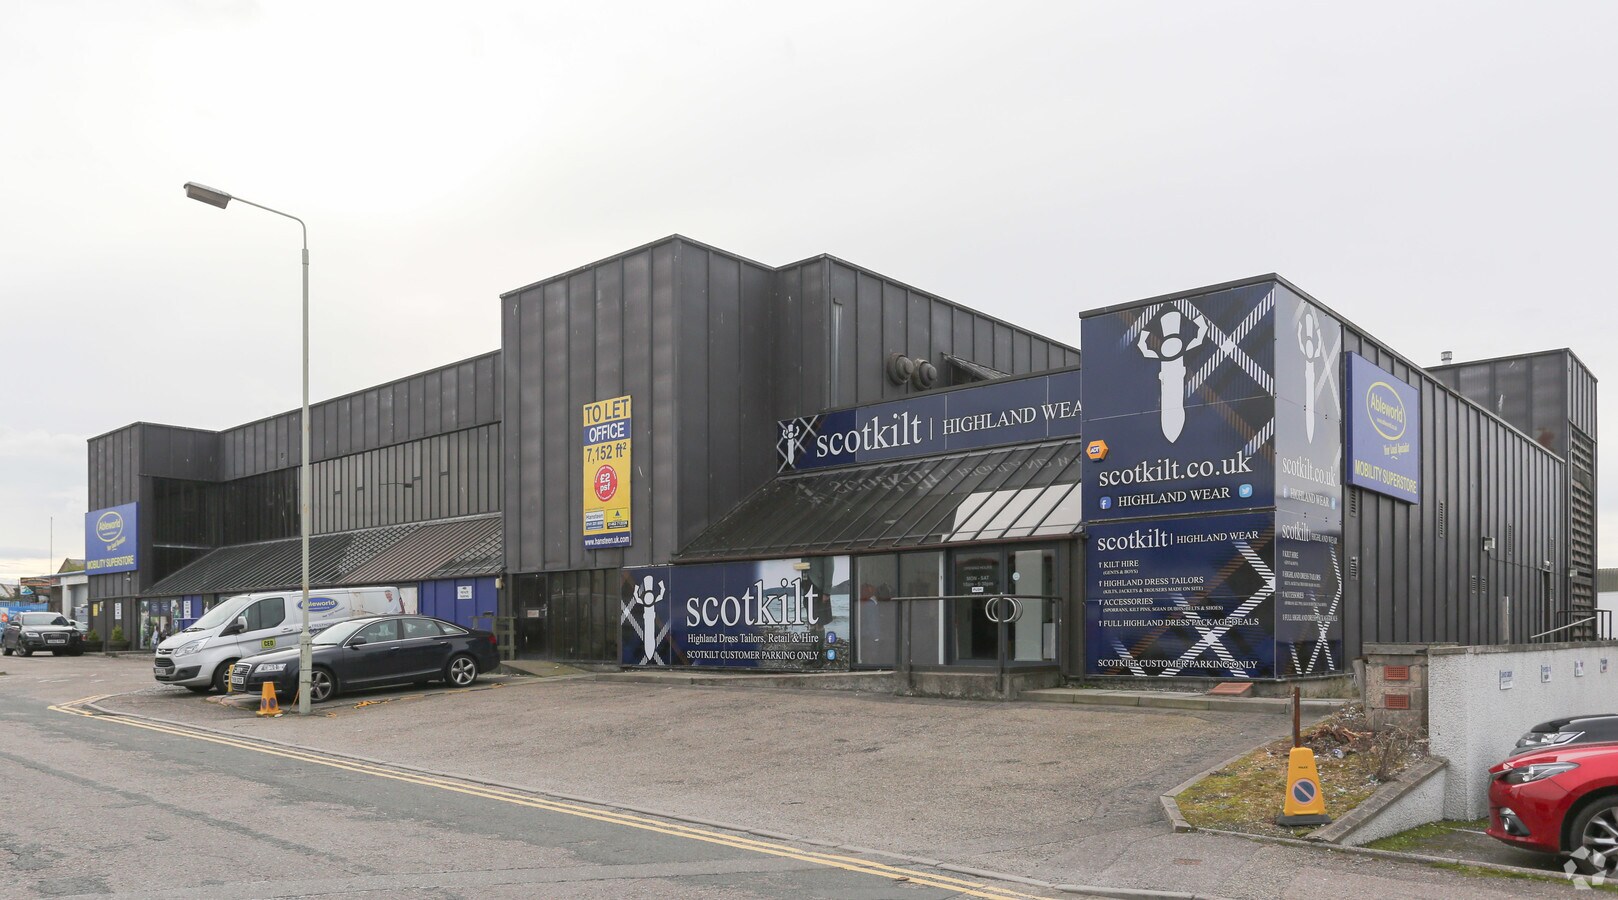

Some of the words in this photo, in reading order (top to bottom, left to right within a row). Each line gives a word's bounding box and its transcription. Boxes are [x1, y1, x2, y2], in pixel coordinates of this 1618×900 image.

[585, 405, 601, 423] TO
[605, 399, 629, 420] LET
[1371, 393, 1403, 423] Ableworld
[589, 422, 625, 442] OFFICE
[816, 411, 922, 458] scotkilt
[943, 406, 1036, 435] HIGHLAND
[1042, 400, 1082, 420] WEA
[587, 445, 612, 464] 7,152
[600, 472, 610, 484] £2
[1099, 450, 1253, 487] scotkilt.co.uk
[1282, 456, 1336, 487] scotkilt.co.uk
[1355, 460, 1382, 482] MOBILITY
[1382, 469, 1417, 494] SUPERSTORE
[600, 482, 610, 495] psf
[1118, 491, 1187, 507] HIGHLAND
[1190, 487, 1231, 500] WEAR
[1290, 487, 1316, 504] HIGHLAND
[1097, 528, 1168, 551] scotkilt
[1177, 532, 1227, 544] HIGHLAND
[1229, 530, 1259, 540] WEAR
[1282, 521, 1309, 542] scotkilt
[87, 560, 106, 570] MOBILITY
[106, 555, 134, 567] SUPERSTORE
[1103, 579, 1143, 587] HIGHLAND
[1170, 576, 1204, 584] TAILORS
[686, 578, 819, 627] scotkilt
[1103, 598, 1154, 606] ACCESSORIES
[1123, 619, 1164, 627] HIGHLAND
[1191, 618, 1229, 626] PACKAGE
[688, 633, 717, 645] Highland
[718, 633, 738, 643] Dress
[740, 633, 767, 644] Tailors,
[768, 632, 790, 643] Retail
[791, 633, 799, 643] &
[801, 633, 819, 643] Hire
[687, 651, 719, 659] SCOTKILT
[720, 651, 761, 659] CUSTOMER
[761, 651, 796, 660] PARKING
[797, 651, 819, 660] ONLY
[1098, 659, 1138, 667] SCOTKILT
[1138, 659, 1188, 668] CUSTOMER
[1188, 660, 1229, 669] PARKING
[1231, 660, 1258, 669] ONLY
